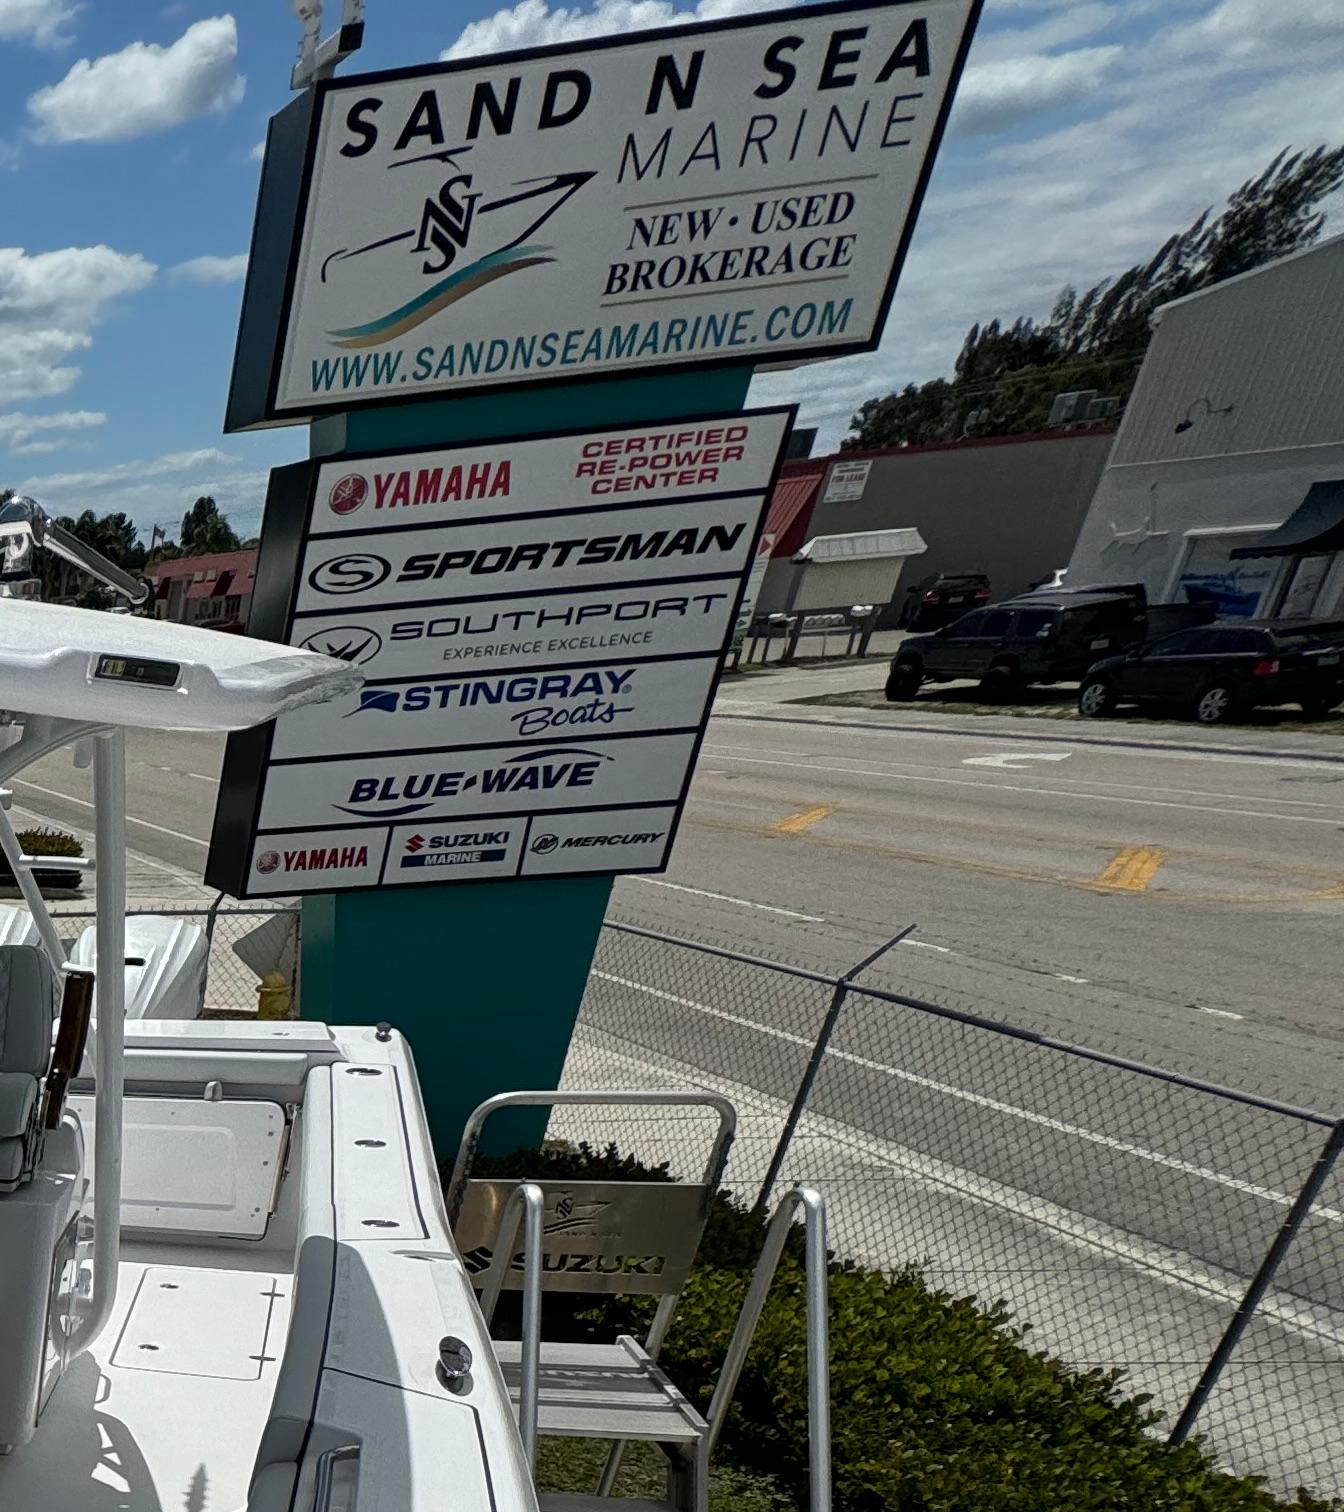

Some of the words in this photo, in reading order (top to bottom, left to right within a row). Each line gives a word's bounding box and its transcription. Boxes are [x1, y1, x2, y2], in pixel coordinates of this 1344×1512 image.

[339, 69, 592, 159] SAND
[645, 50, 705, 115] N
[755, 18, 932, 101] SEA
[616, 93, 924, 185] MARINE
[628, 202, 724, 252] NEW
[749, 191, 857, 236] USED
[602, 234, 858, 297] BROKERAGE
[311, 298, 854, 393] WWW.SANDNSEAMARINE.COM
[575, 445, 745, 478] RE-POWER
[581, 425, 749, 459] CERTIFIED
[373, 460, 512, 510] YAMAHA
[590, 467, 720, 496] CENTER
[396, 522, 747, 584] SPORTSMAN
[390, 593, 727, 642] SOUTHPORT
[442, 639, 541, 662] EXPERIENCE
[547, 630, 653, 654] EXCELLENCE
[402, 668, 637, 713] STINGRAY
[511, 701, 636, 736] Boats
[348, 771, 465, 803] BLUE
[481, 760, 601, 794] WAVE
[283, 846, 368, 871] YAMAHA
[424, 851, 482, 866] MARINE
[428, 831, 510, 850] SUZUKI
[560, 832, 666, 849] MERCURY
